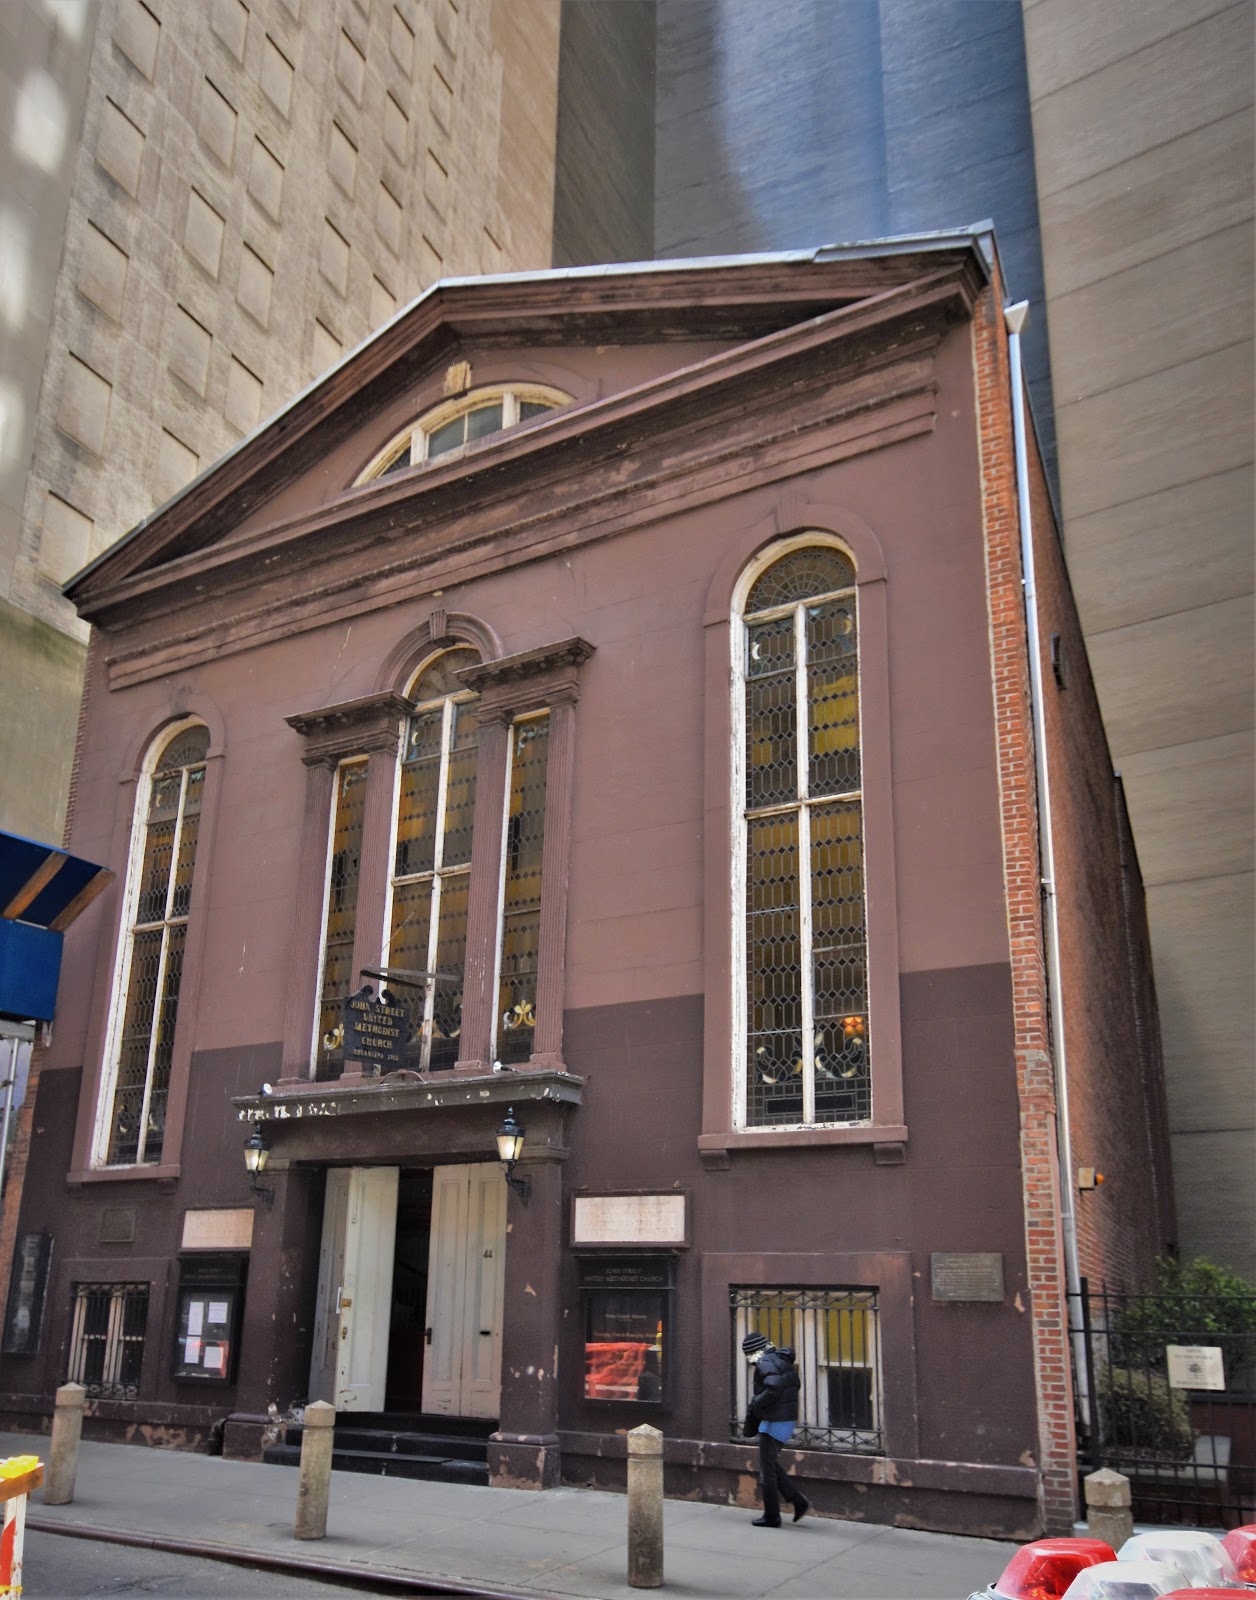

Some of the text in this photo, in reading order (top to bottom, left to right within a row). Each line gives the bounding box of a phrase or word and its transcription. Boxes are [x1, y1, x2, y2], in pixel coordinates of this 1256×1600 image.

[350, 1001, 405, 1017] JOHN STREET
[363, 1012, 393, 1025] UNITED
[354, 1022, 400, 1037] METHODIST
[361, 1036, 393, 1049] CHURCH
[483, 1249, 493, 1258] 44
